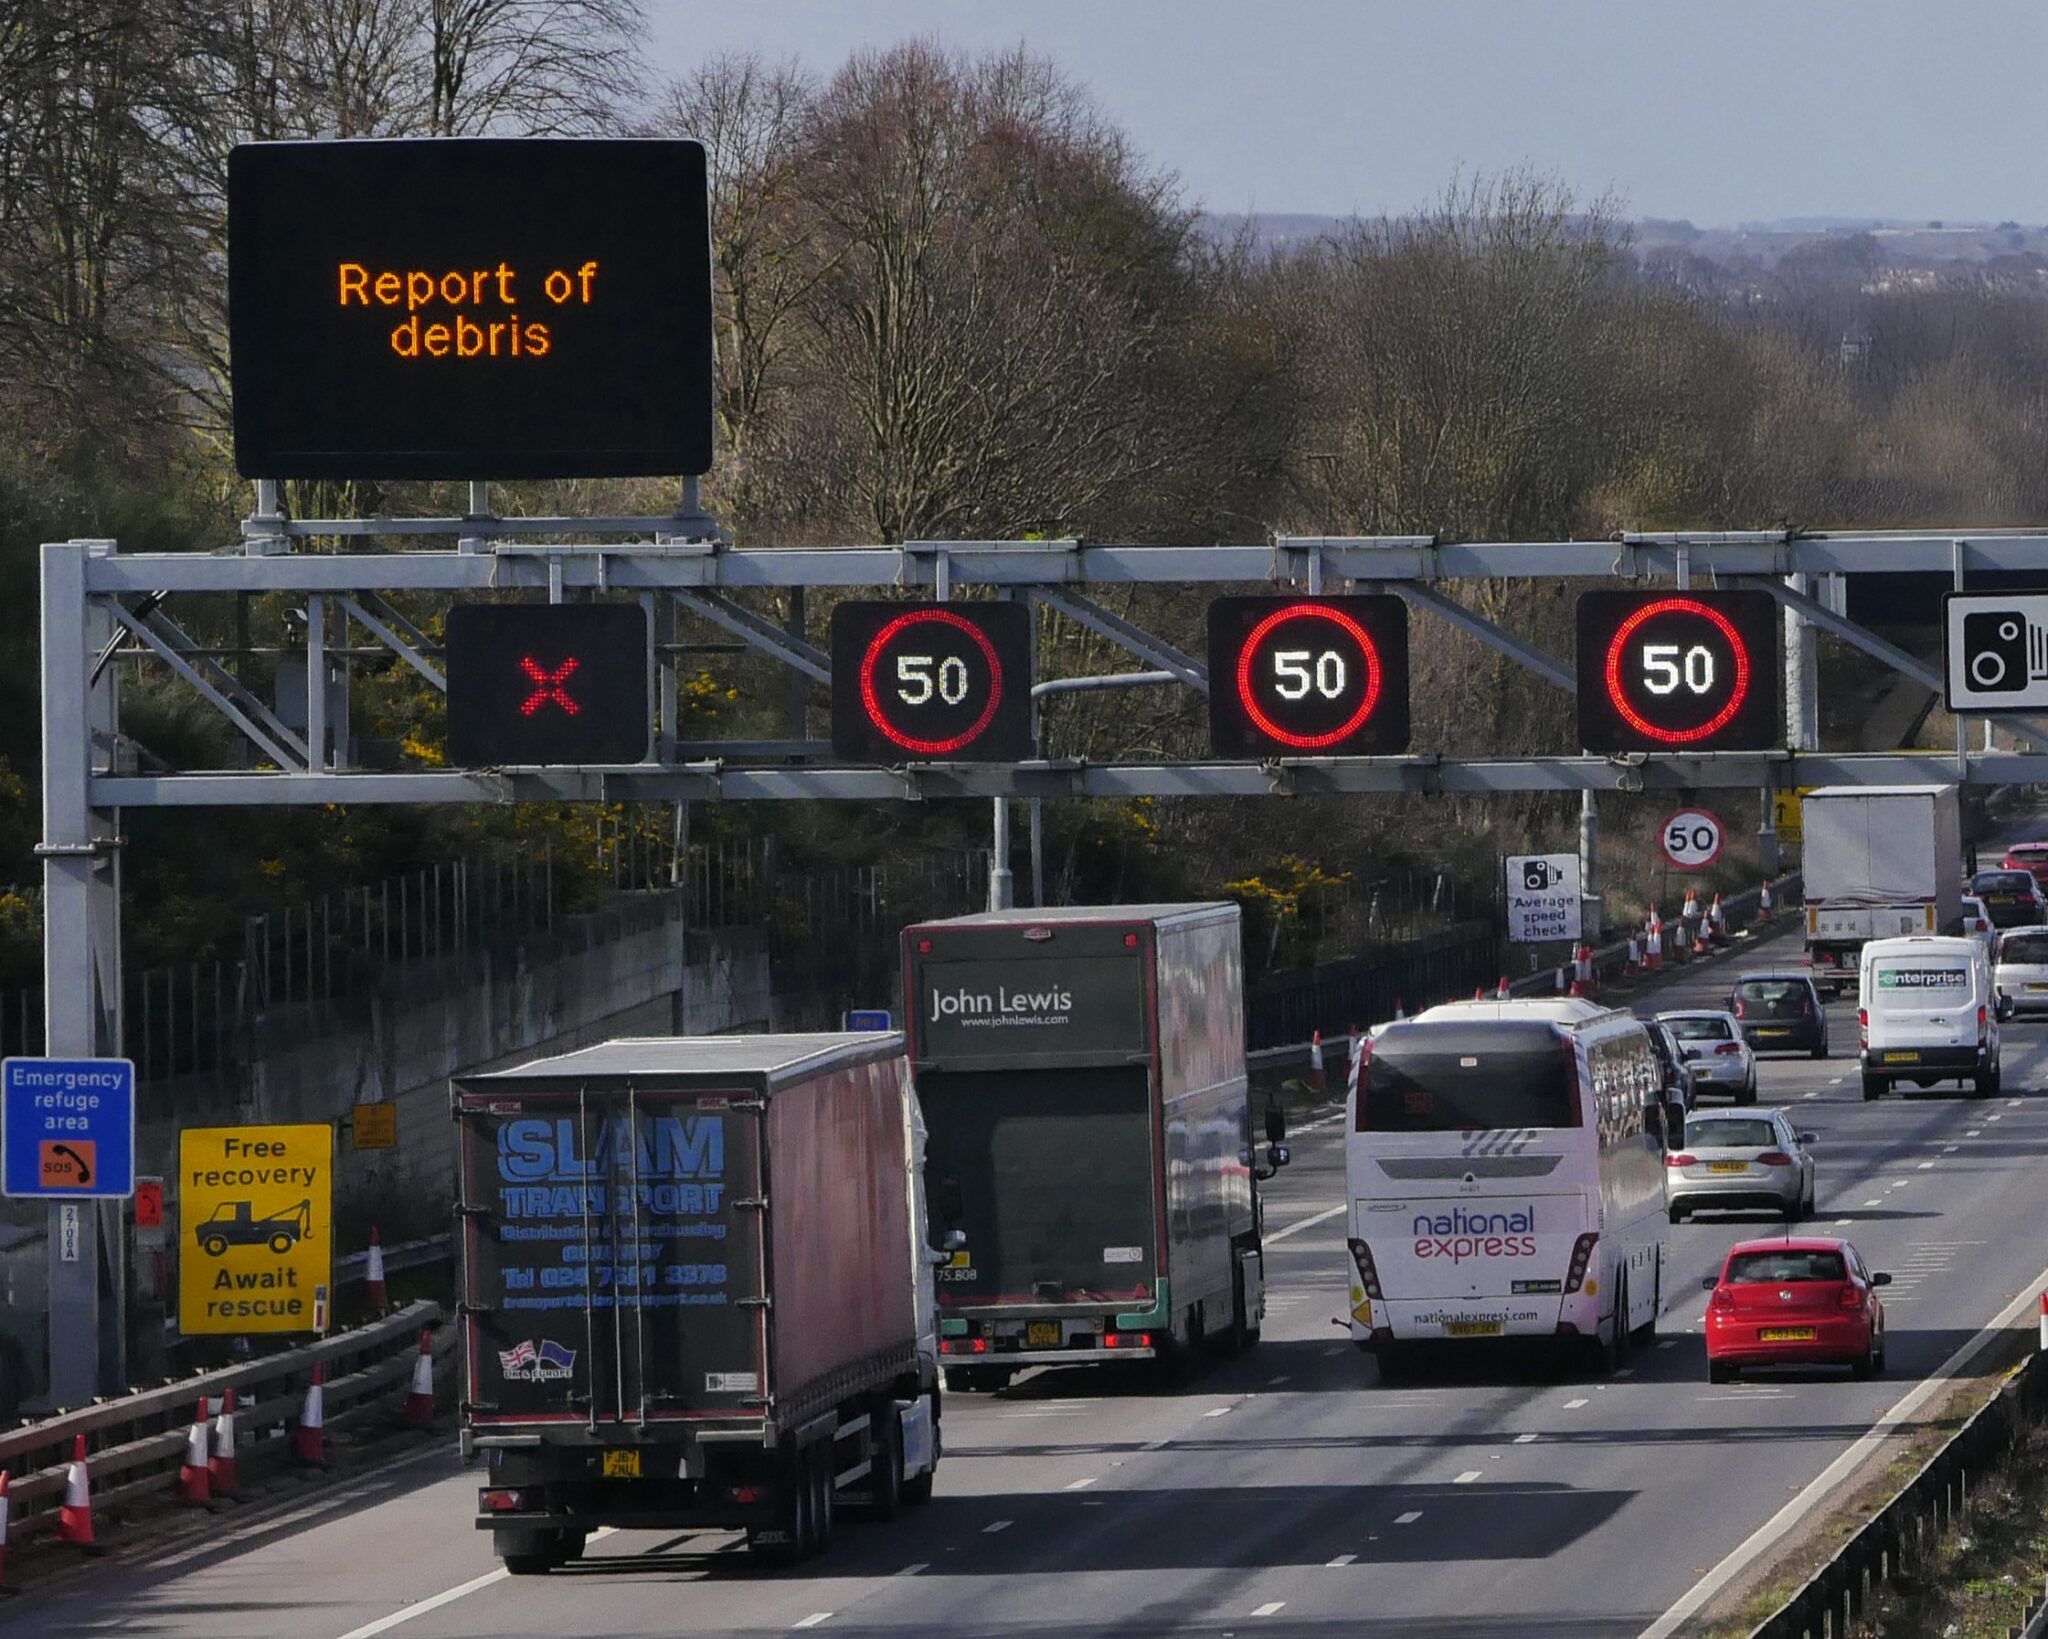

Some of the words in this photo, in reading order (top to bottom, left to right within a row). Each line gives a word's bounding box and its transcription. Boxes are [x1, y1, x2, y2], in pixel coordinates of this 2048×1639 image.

[339, 262, 515, 310] Report
[545, 262, 597, 303] of
[391, 315, 551, 357] debris
[897, 655, 969, 705] 50
[1273, 650, 1346, 699] 50
[1643, 645, 1714, 694] 50
[1669, 826, 1714, 851] 50
[1514, 897, 1574, 909] Average
[1523, 910, 1566, 923] speed
[1523, 924, 1567, 937] check
[1883, 970, 1965, 986] enterprise
[931, 987, 992, 1021] John
[1000, 985, 1072, 1012] Lewis
[961, 1014, 1069, 1028] www.johnlewis.com
[12, 1068, 124, 1090] Emergency
[35, 1091, 99, 1111] refuge
[45, 1117, 89, 1130] area
[224, 1138, 286, 1158] Free
[497, 1115, 725, 1183] SLAM
[193, 1167, 317, 1187] recovery
[1413, 1206, 1534, 1236] national
[1414, 1236, 1536, 1265] express
[213, 1267, 298, 1290] Await
[207, 1300, 302, 1317] rescue
[1414, 1310, 1538, 1324] nationalexpress.com
